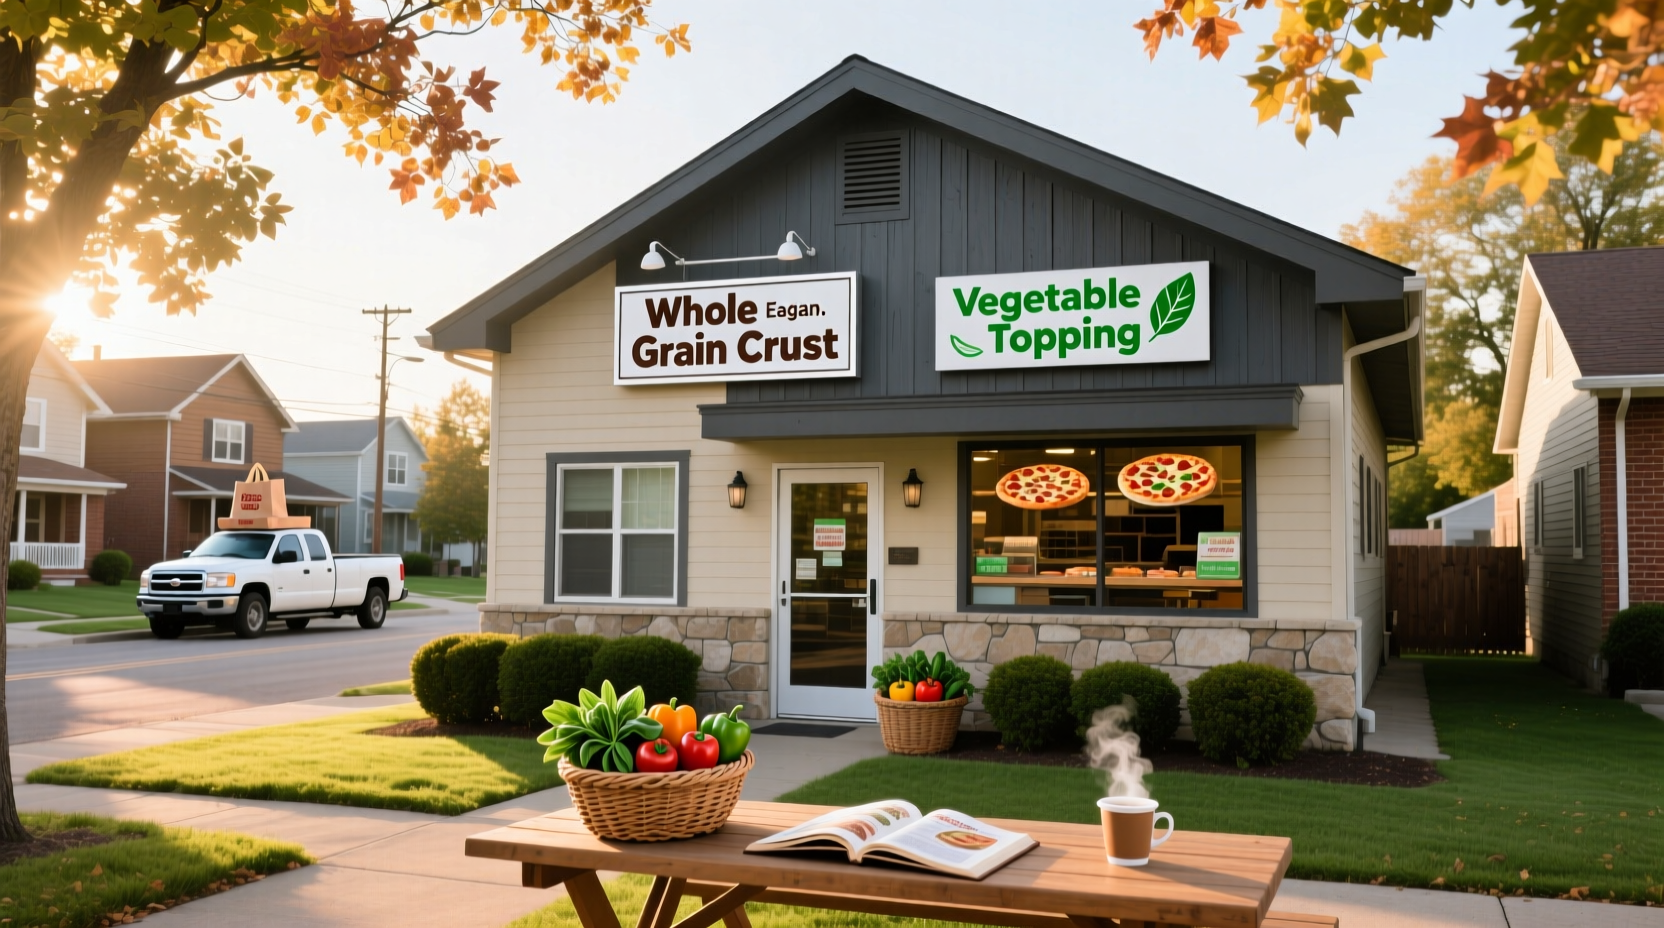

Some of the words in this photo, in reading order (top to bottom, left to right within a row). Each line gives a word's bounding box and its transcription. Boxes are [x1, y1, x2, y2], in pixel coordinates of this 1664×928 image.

[645, 293, 758, 329] Whole
[766, 301, 826, 321] Eagan.
[952, 277, 1141, 323] Vegetable
[631, 332, 727, 369] Grain
[736, 328, 839, 363] Crust
[987, 316, 1141, 360] Topping
